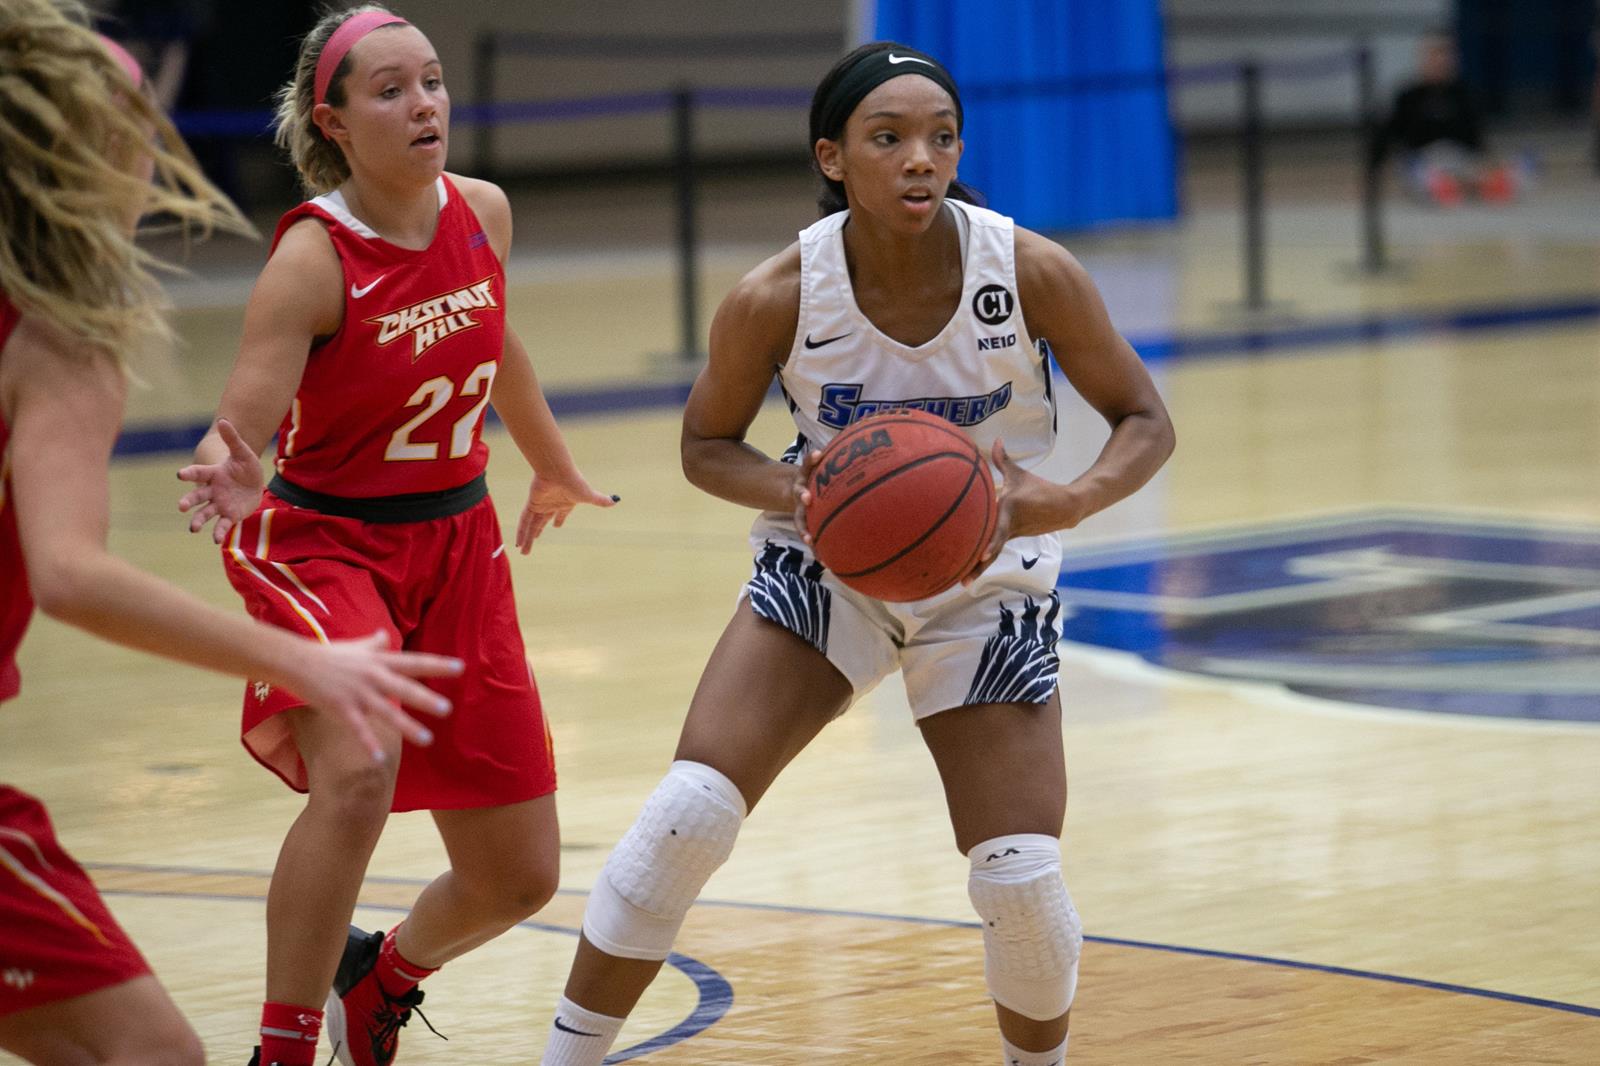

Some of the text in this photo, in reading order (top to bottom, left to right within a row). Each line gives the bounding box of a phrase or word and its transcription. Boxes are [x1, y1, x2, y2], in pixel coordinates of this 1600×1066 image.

[369, 277, 498, 345] CHESTNUT
[976, 290, 1010, 319] CI
[977, 333, 1017, 351] NE10
[384, 360, 497, 461] 22
[818, 381, 1012, 430] SOHERN
[815, 429, 893, 497] NCAA
